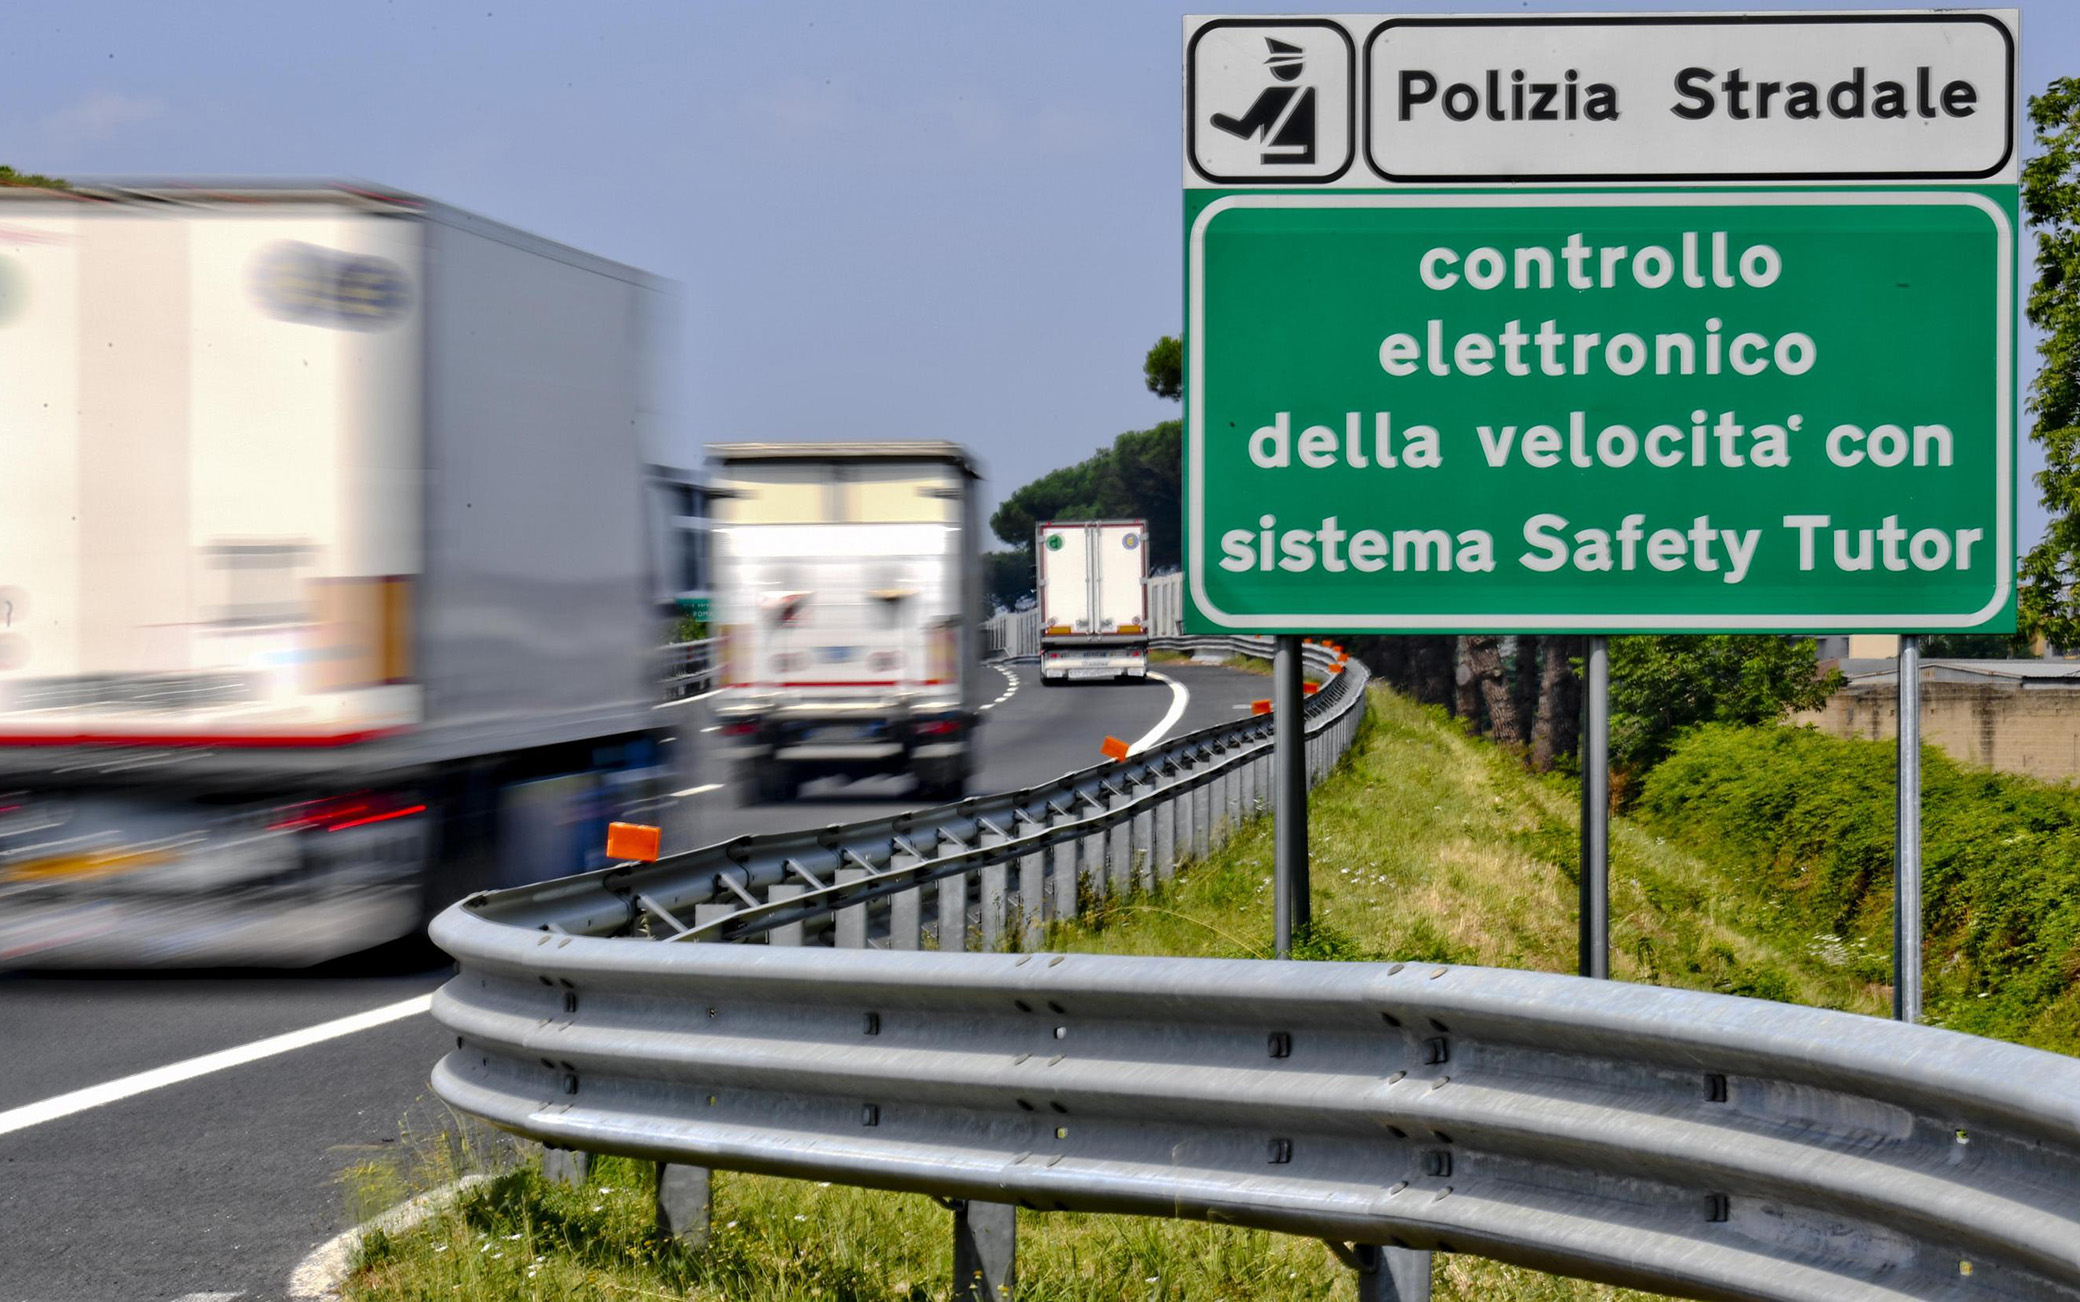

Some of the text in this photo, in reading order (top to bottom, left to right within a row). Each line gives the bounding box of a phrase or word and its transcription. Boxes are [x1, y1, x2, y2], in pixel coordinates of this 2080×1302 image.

[1399, 67, 1979, 123] Polizia Stradale
[1420, 231, 1782, 291] controllo
[1379, 318, 1818, 377] elettronico
[1249, 412, 1442, 469] della
[1826, 424, 1955, 469] con
[1220, 514, 1984, 584] sistema Safety Tutor
